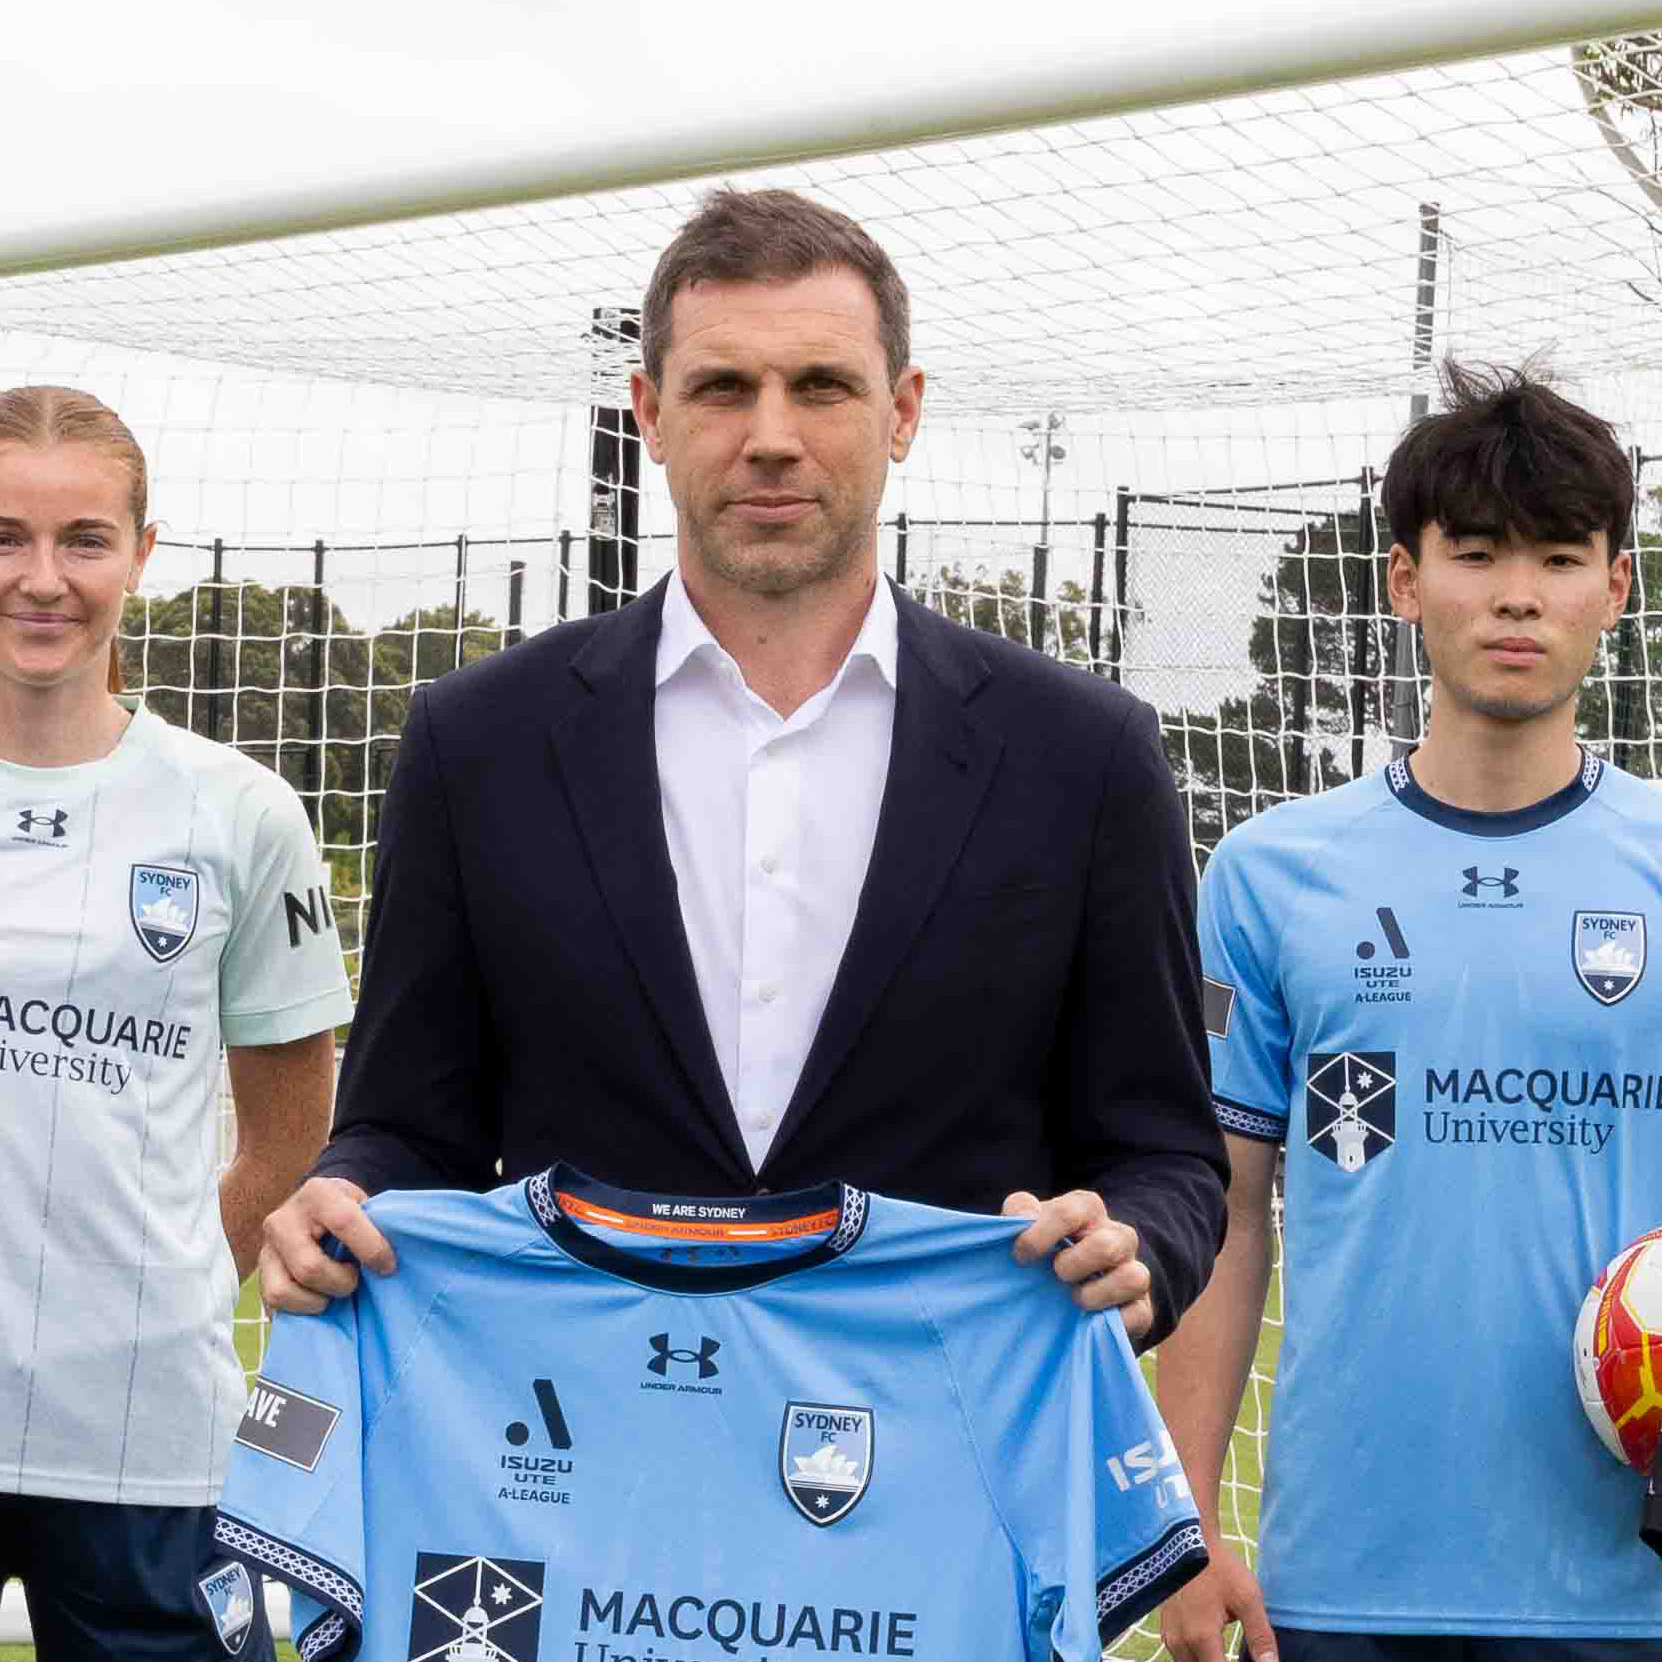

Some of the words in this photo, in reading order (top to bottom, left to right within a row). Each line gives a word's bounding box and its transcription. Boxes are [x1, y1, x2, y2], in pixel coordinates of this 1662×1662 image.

[140, 872, 191, 890] SYDNEY
[160, 886, 172, 897] FC
[1583, 917, 1637, 932] SYDNEY
[1604, 931, 1616, 940] FC
[1354, 967, 1412, 978] ISUZU
[1366, 979, 1400, 988] UTE
[1355, 992, 1412, 1003] A-LEAGUE
[1423, 1111, 1616, 1155] University
[652, 1203, 671, 1216] WE
[672, 1204, 697, 1217] ARE
[698, 1205, 746, 1219] SYDNEY
[640, 1381, 676, 1391] UNDER
[677, 1385, 723, 1395] ARMOUR
[795, 1412, 863, 1432] SYDNEY
[821, 1431, 837, 1443] FC
[501, 1455, 573, 1473] ISUZU
[514, 1473, 557, 1485] UTE
[498, 1487, 571, 1504] A-LEAGUE
[206, 1567, 242, 1597] SYDNEY
[579, 1587, 918, 1657] MACQUARIE
